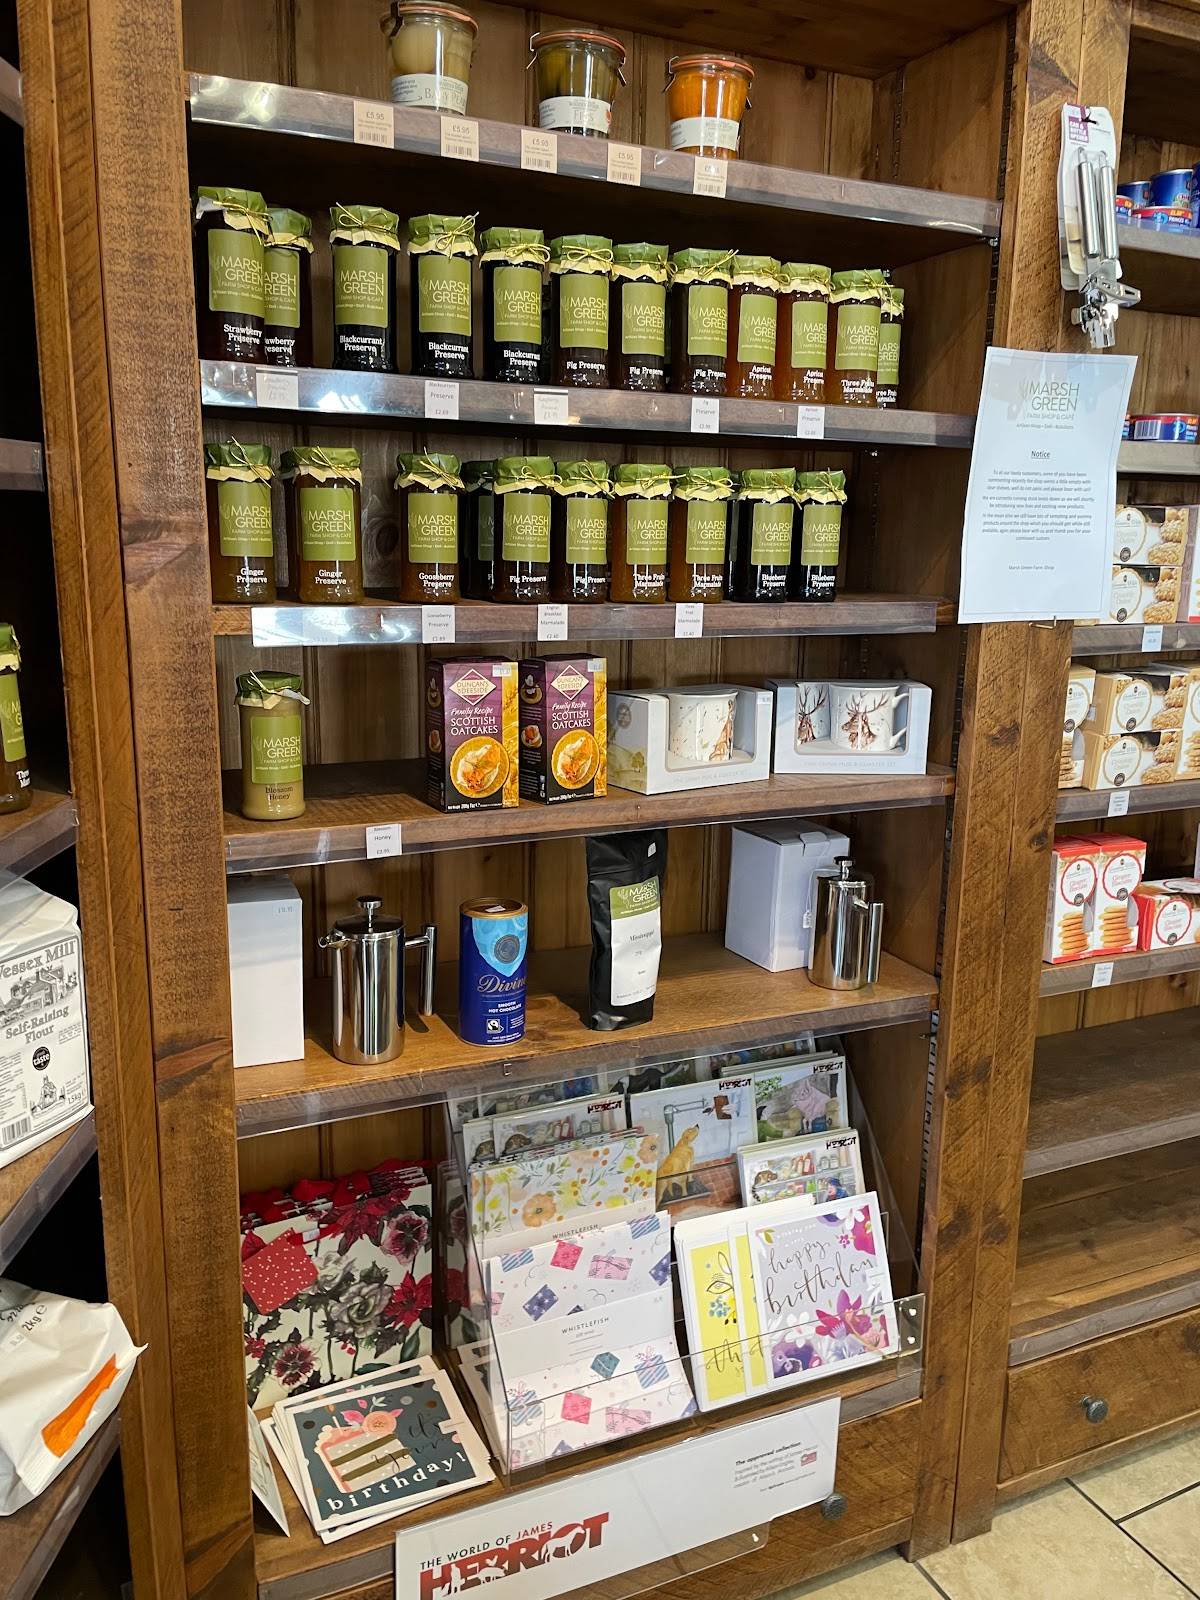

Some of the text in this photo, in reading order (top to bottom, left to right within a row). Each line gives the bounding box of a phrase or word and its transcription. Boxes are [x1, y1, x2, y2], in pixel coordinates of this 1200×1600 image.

[221, 256, 263, 272] MARSH
[225, 268, 263, 285] GREEN
[264, 271, 296, 285] ARSH
[340, 270, 384, 285] MARSH
[264, 283, 296, 297] REEN
[343, 282, 384, 297] GREEN
[429, 280, 469, 293] MARSH
[432, 291, 469, 305] GREEN
[699, 308, 727, 319] MARS
[702, 317, 727, 329] GREE
[751, 315, 776, 328] MARS
[223, 324, 262, 338] Strawberry
[753, 326, 776, 338] GREE
[803, 323, 827, 333] MARS
[339, 335, 382, 345] Blackcurrant
[435, 350, 465, 360] Preserve
[509, 358, 537, 367] Preserve
[566, 361, 577, 370] Fig
[1029, 381, 1080, 397] MARSH
[1031, 396, 1077, 412] GREEN
[1031, 450, 1050, 458] Notice
[230, 505, 271, 517] MARSH
[308, 510, 351, 521] MARSH
[235, 517, 271, 528] GREEN
[312, 520, 351, 532] GREEN
[417, 515, 456, 526] MARSH
[512, 514, 548, 526] MARSH
[421, 525, 456, 536] GREEN
[516, 525, 548, 536] GREEN
[240, 568, 264, 577] Ginger
[319, 570, 343, 578] Ginger
[236, 576, 267, 584] Preserve
[315, 577, 346, 585] Preserve
[456, 680, 489, 688] DUNCAN'S
[473, 706, 494, 716] Recipe
[552, 710, 589, 721] SCOTTISH
[451, 716, 496, 727] SCOTTISH
[552, 719, 591, 730] OATCAKES
[451, 725, 498, 736] OATCAKES
[263, 735, 300, 748] MARSH
[45, 940, 75, 963] Mill
[5, 1005, 69, 1040] Self-Raising
[25, 1024, 55, 1045] Flour
[552, 1223, 600, 1240] WHISTLEFISH
[768, 1239, 831, 1275] happy
[764, 1252, 875, 1316] birthday
[561, 1316, 610, 1334] WHISTLEFISH
[327, 1451, 467, 1512] birthday!
[420, 1521, 553, 1570] THE WORLD OF JAMES
[419, 1511, 610, 1600] HERRIOT
